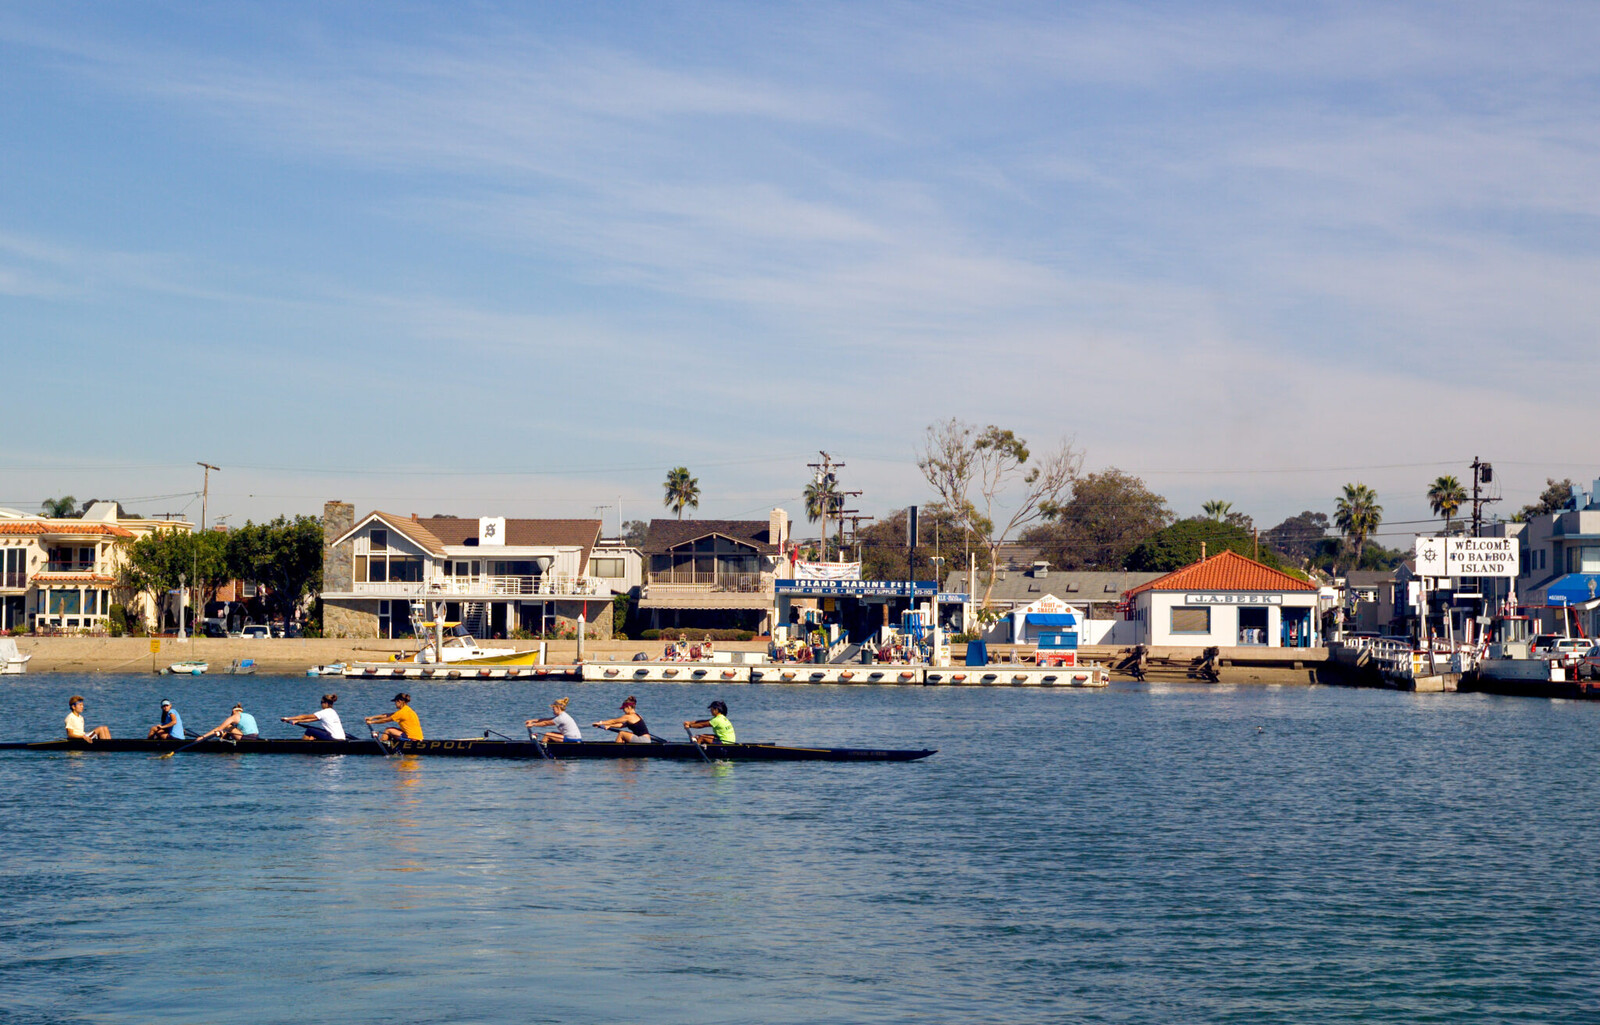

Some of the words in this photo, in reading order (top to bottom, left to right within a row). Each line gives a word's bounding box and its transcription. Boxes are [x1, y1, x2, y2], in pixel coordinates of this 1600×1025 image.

[1455, 541, 1511, 551] WELCOME
[1450, 552, 1465, 561] TO
[1468, 552, 1515, 562] BALBOA
[1461, 563, 1505, 573] ISLAND
[841, 580, 886, 588] MARINE
[389, 741, 474, 749] VESPOLI
